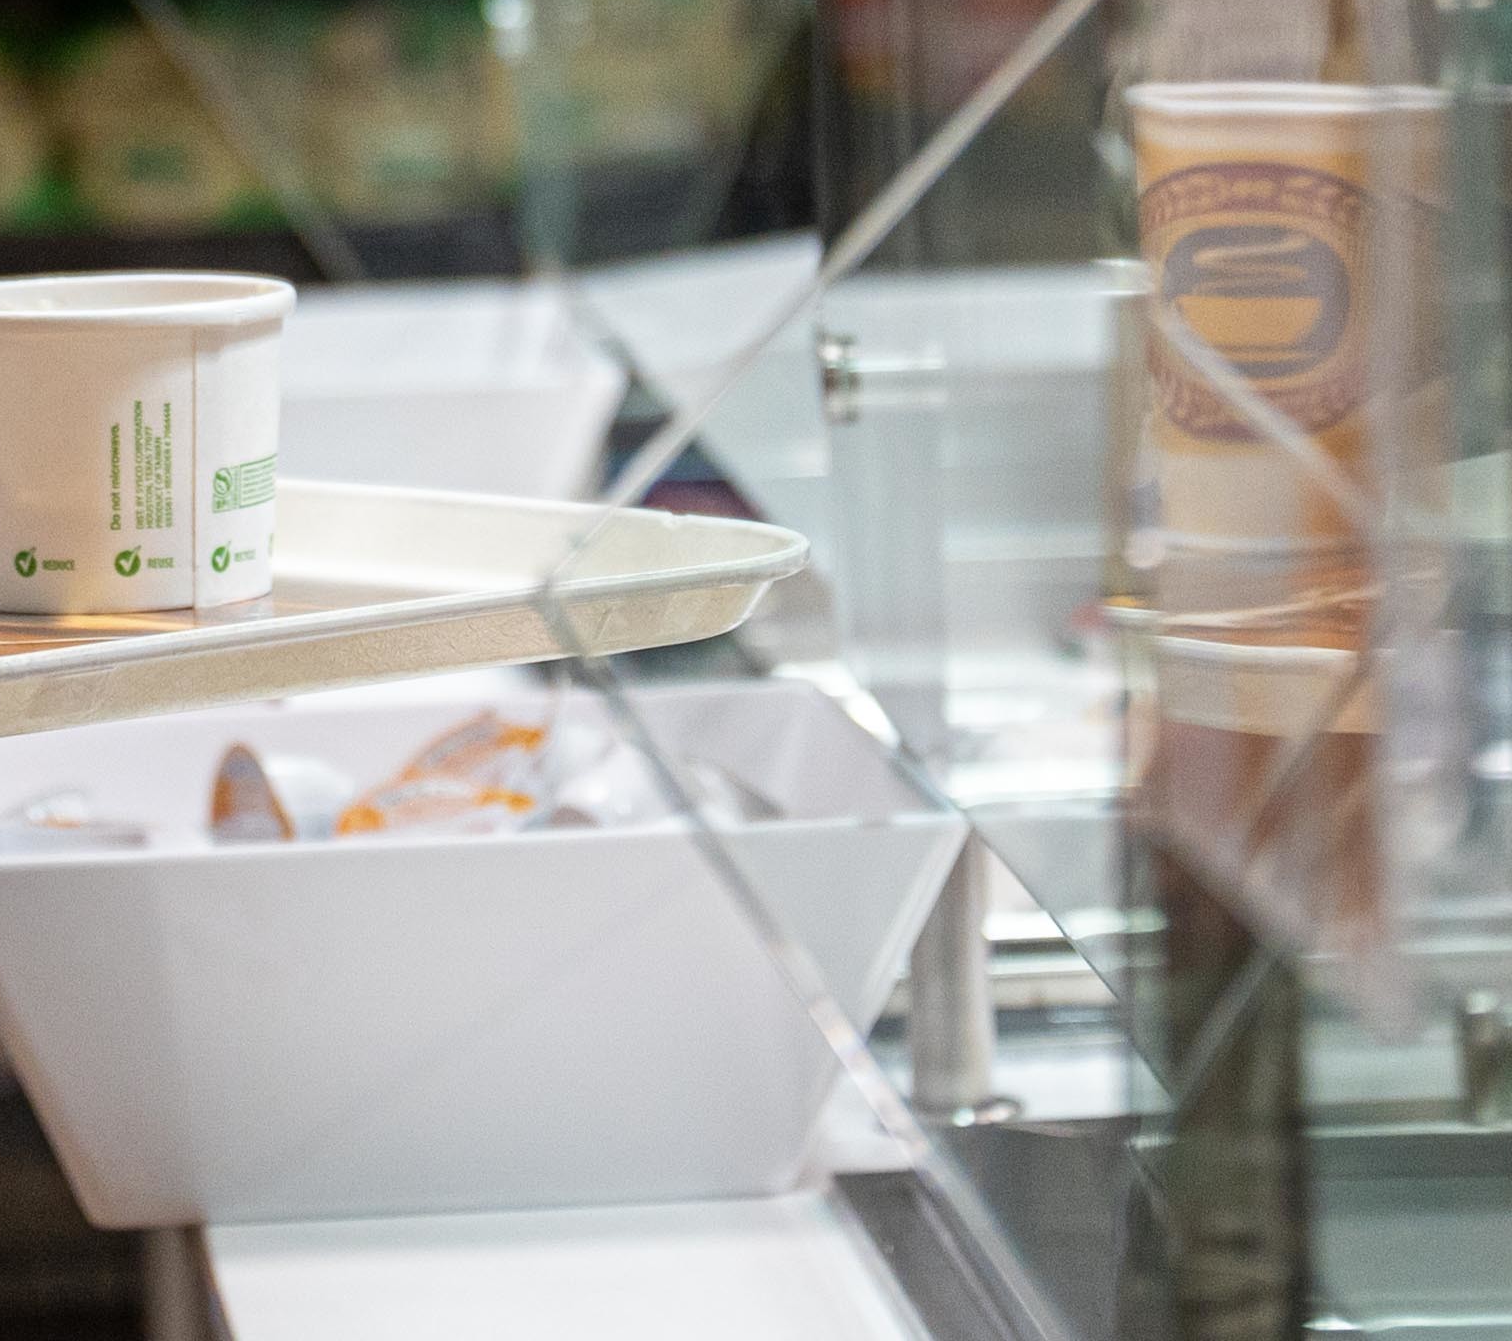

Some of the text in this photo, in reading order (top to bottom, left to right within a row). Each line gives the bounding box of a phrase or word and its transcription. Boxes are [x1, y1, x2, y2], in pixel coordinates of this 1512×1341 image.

[134, 400, 144, 464] CORPORATION
[145, 454, 153, 481] TEXAS
[135, 465, 144, 494] SYSCO
[110, 492, 121, 511] not
[110, 514, 121, 530] Do
[42, 559, 76, 571] REDUCE
[147, 557, 175, 569] REUSE
